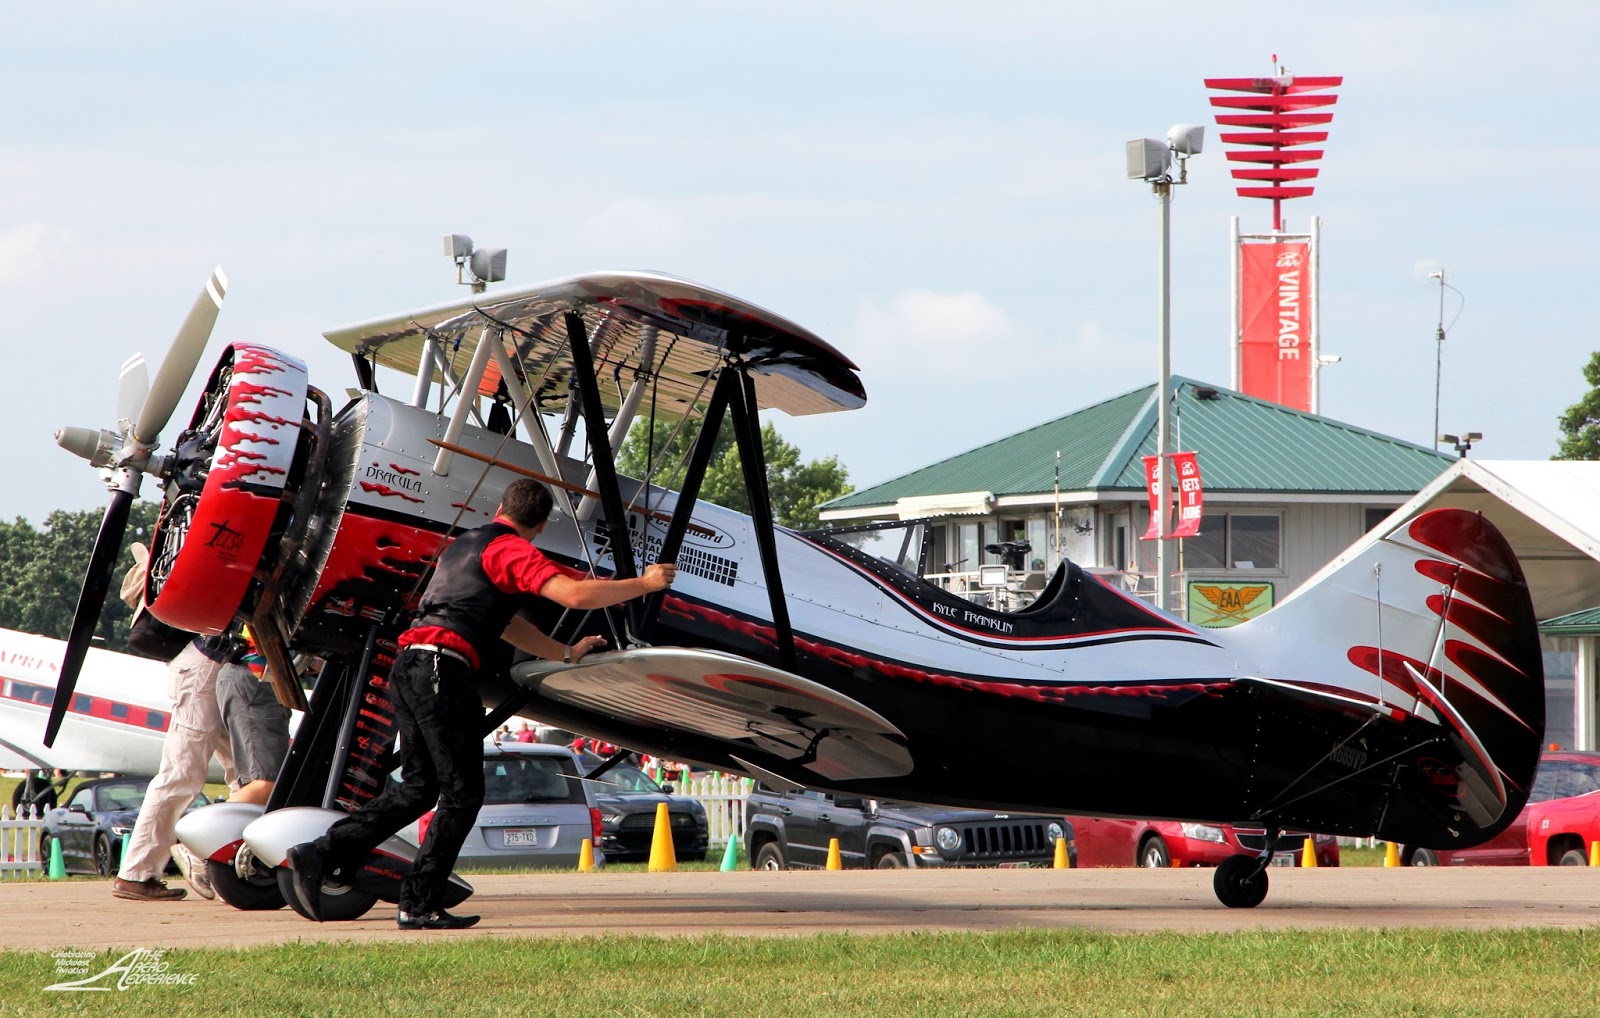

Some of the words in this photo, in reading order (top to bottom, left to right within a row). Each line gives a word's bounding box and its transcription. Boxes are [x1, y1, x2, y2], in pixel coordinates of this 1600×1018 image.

[1278, 270, 1299, 360] VINTAGE
[365, 466, 422, 493] DRACULA
[1182, 478, 1200, 492] GETS
[1188, 492, 1196, 505] IT
[1182, 505, 1201, 520] DONE
[1220, 592, 1242, 608] EAA
[932, 602, 958, 618] KYLE
[964, 610, 1014, 633] FRANKLIN
